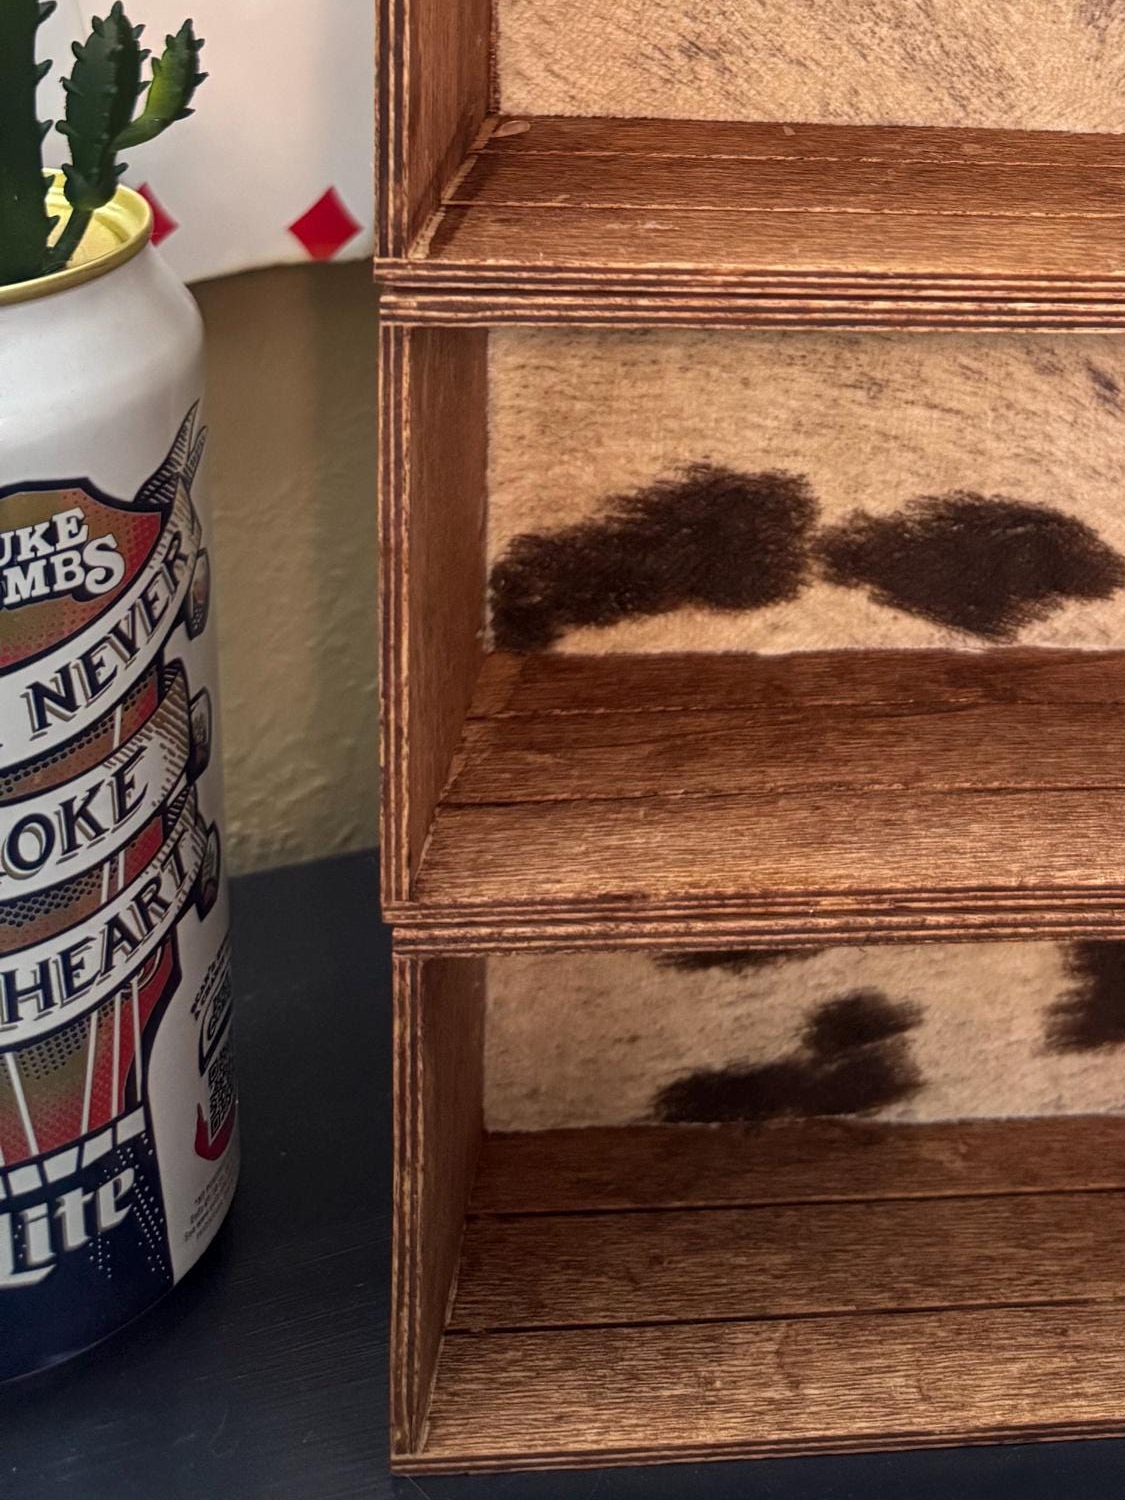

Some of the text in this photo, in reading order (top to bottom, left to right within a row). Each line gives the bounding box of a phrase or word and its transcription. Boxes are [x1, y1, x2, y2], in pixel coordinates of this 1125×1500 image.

[20, 530, 190, 740] NEVER
[2, 745, 149, 878] OKE
[0, 826, 190, 1028] HEART
[0, 1168, 135, 1288] Lite
